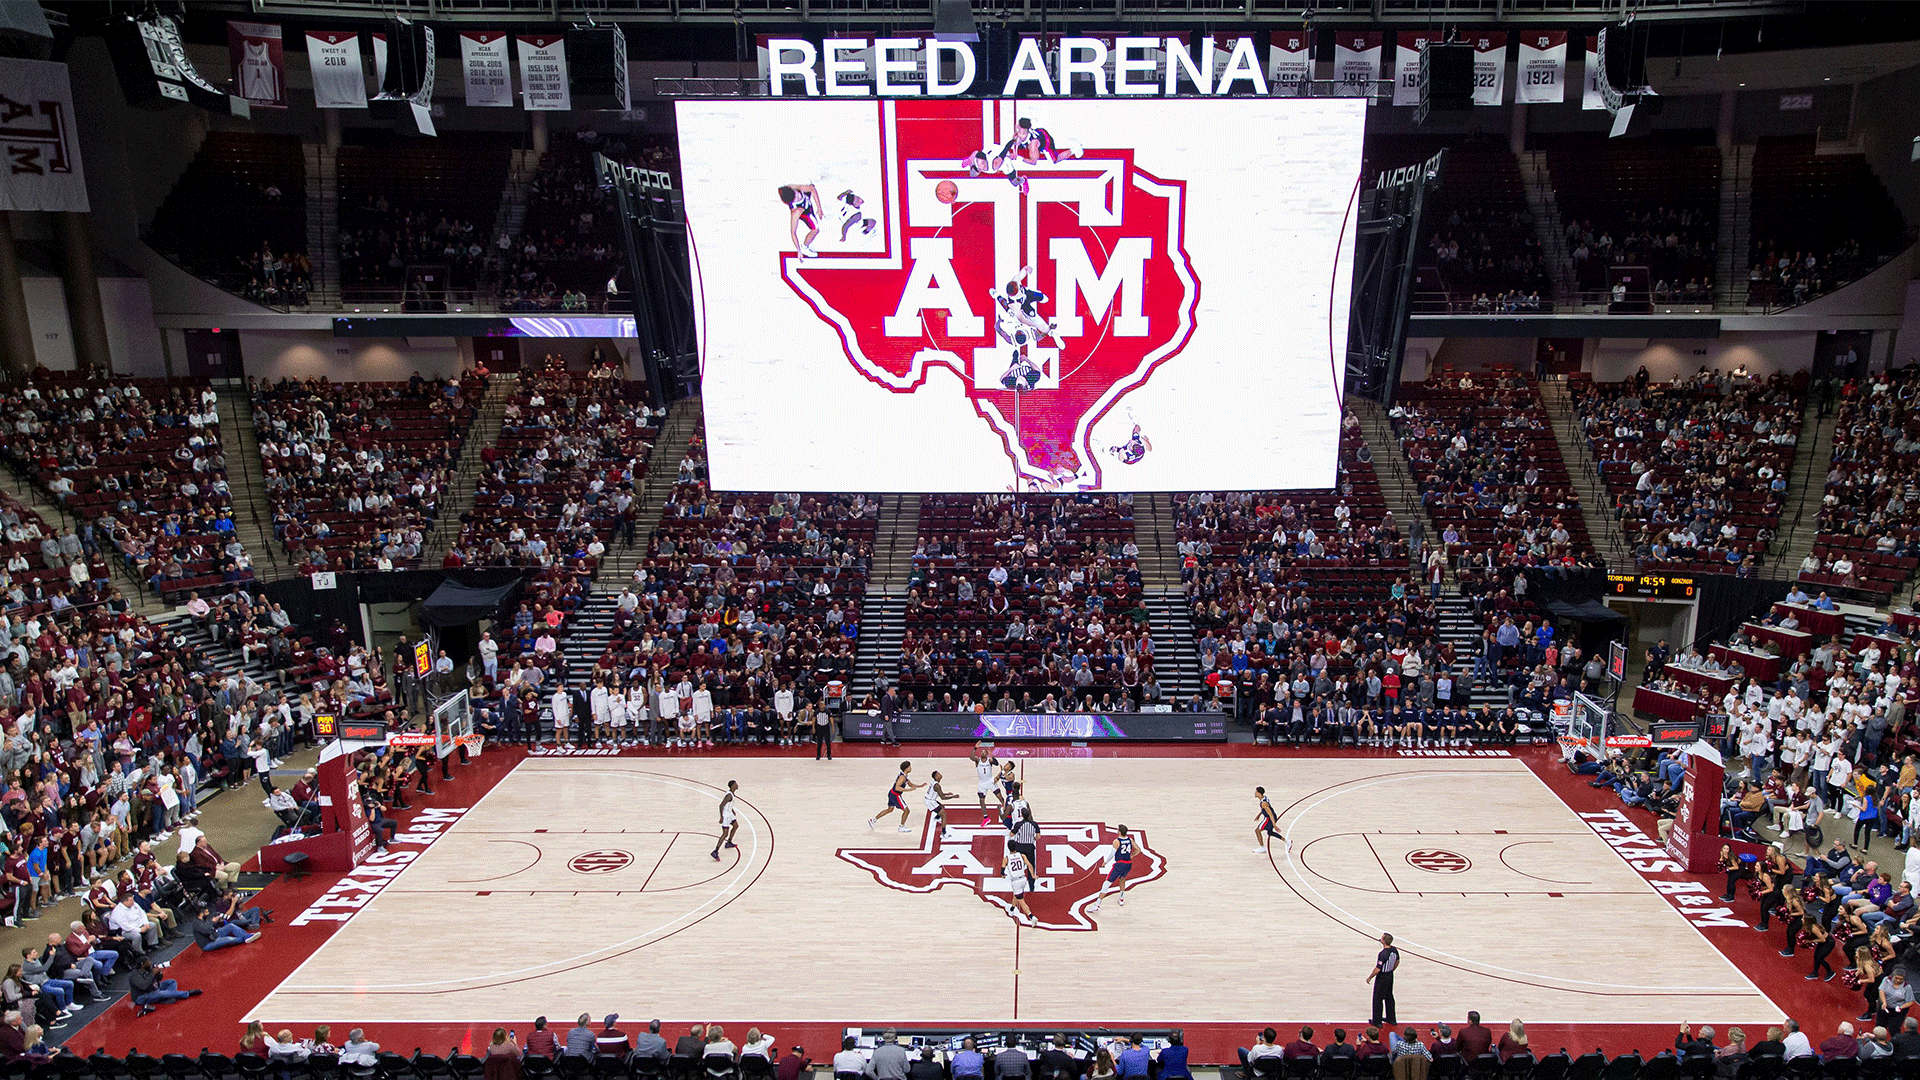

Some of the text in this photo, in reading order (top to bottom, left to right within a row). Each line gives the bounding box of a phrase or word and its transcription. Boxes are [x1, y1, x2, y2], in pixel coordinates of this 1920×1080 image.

[324, 57, 347, 66] 2018
[768, 37, 1269, 96] REED ARENA
[1526, 71, 1556, 85] 1921
[1780, 96, 1813, 110] 225
[1617, 583, 1623, 592] 0
[1640, 576, 1666, 587] 19:59
[1686, 586, 1693, 596] 0
[319, 724, 332, 734] 30
[352, 822, 369, 838] WELLS
[1674, 824, 1690, 841] WELLS
[354, 830, 370, 846] FARGO
[1672, 831, 1688, 848] FARGO
[1120, 844, 1131, 854] 24
[289, 807, 469, 926] TEXAS A&M
[1010, 860, 1022, 872] 20
[1578, 809, 1749, 928] TEXAS A&M
